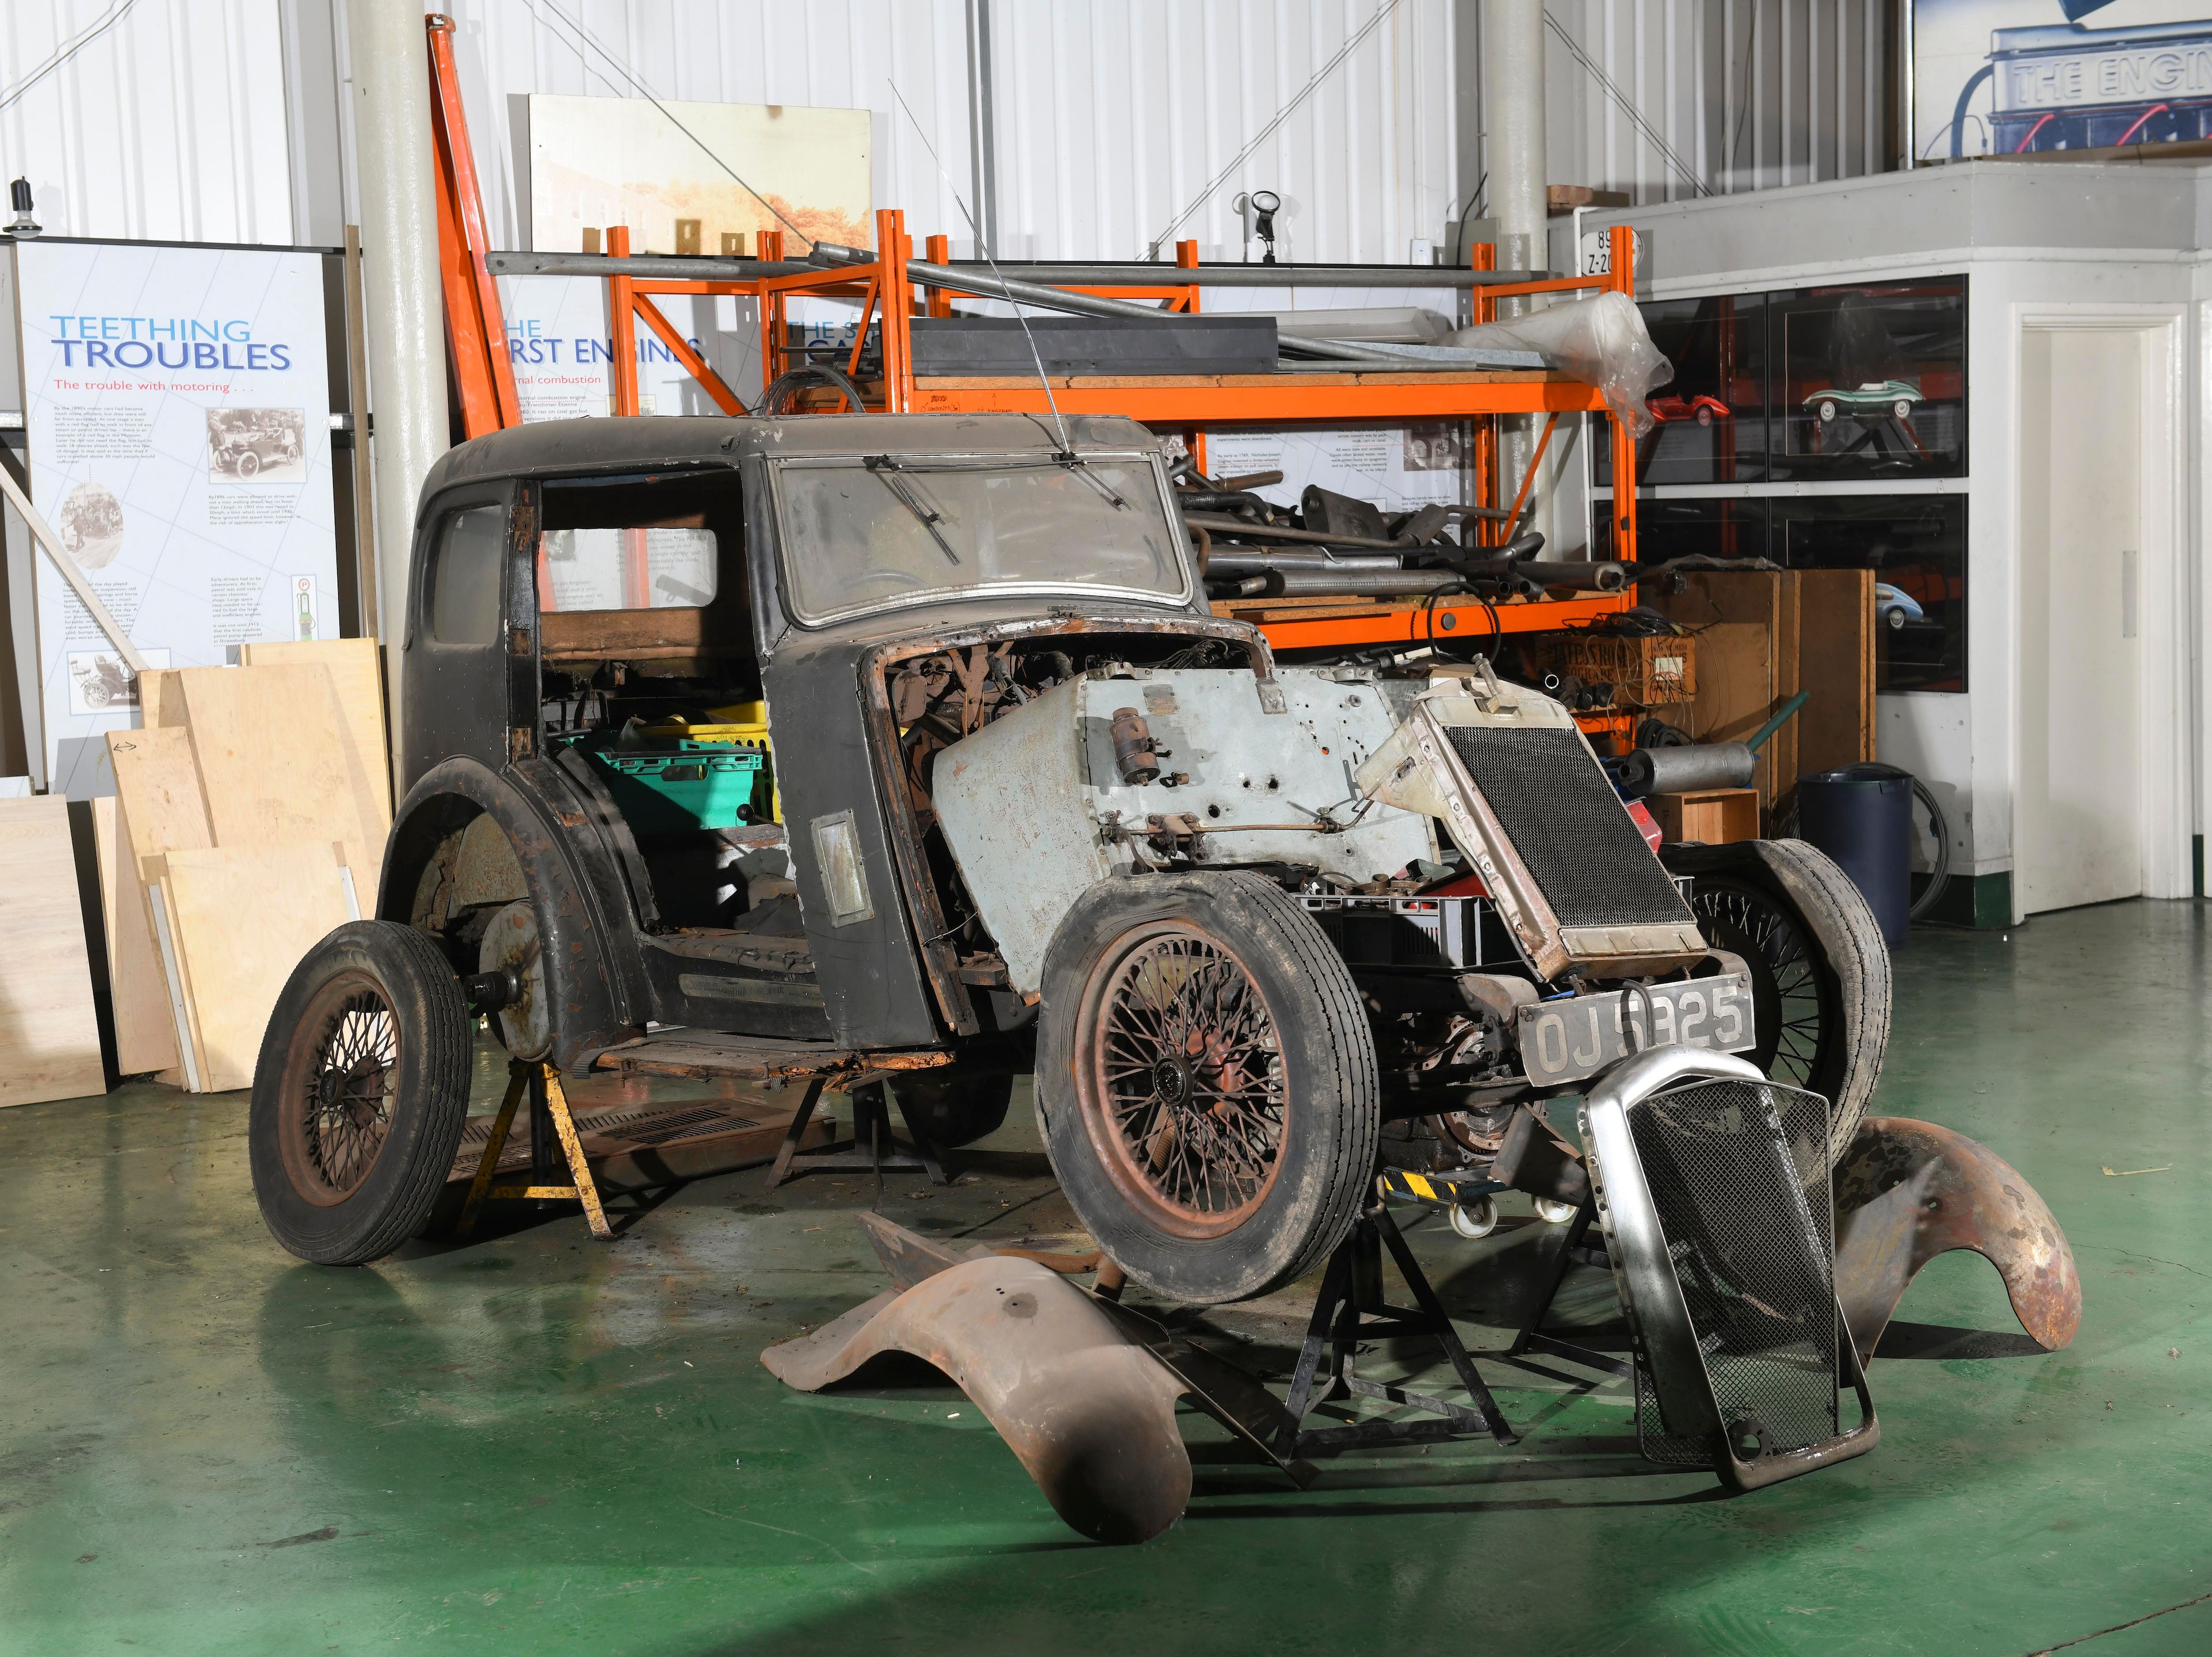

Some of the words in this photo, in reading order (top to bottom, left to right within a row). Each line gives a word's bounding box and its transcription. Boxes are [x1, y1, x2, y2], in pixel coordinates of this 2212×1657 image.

[2013, 62, 2081, 102] THE
[49, 315, 251, 342] TEETHING
[505, 320, 541, 338] HE
[786, 322, 835, 339] THE
[51, 340, 290, 370] TROUBLES
[510, 339, 563, 363] RST
[54, 379, 79, 390] The
[85, 380, 133, 391] trouble
[138, 381, 166, 391] with
[171, 383, 230, 394] motoring
[515, 376, 533, 384] rnal
[538, 376, 601, 384] combustion
[1536, 1007, 1601, 1073] OJ
